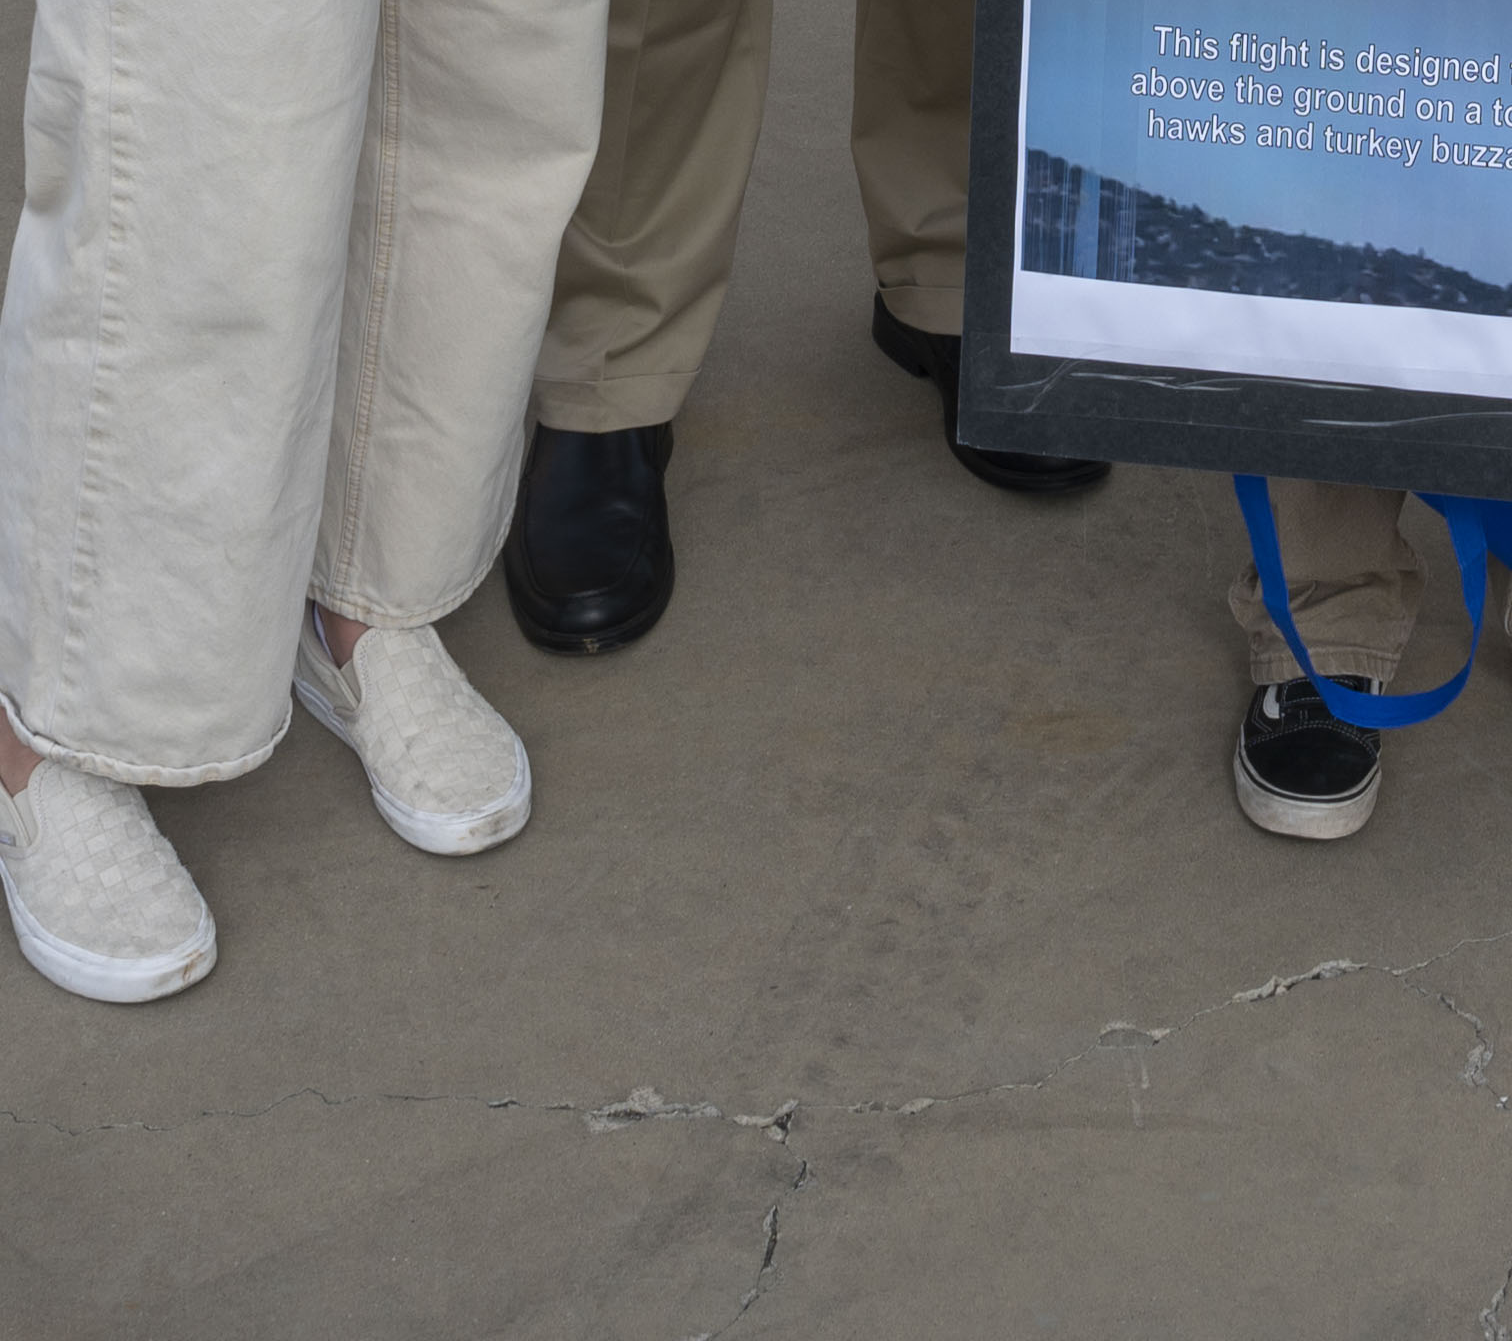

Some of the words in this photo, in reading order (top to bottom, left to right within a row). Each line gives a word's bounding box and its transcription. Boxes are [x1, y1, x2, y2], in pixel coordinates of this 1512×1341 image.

[1152, 24, 1220, 62] This
[1228, 31, 1311, 74] flight
[1318, 46, 1346, 73] is
[1354, 42, 1501, 88] designed
[1129, 65, 1226, 103] above
[1233, 73, 1285, 108] the
[1292, 85, 1407, 120] ground
[1414, 96, 1456, 124] on
[1463, 100, 1483, 126] a
[1146, 107, 1247, 146] hawks
[1255, 120, 1315, 152] and
[1322, 124, 1423, 169] turkey
